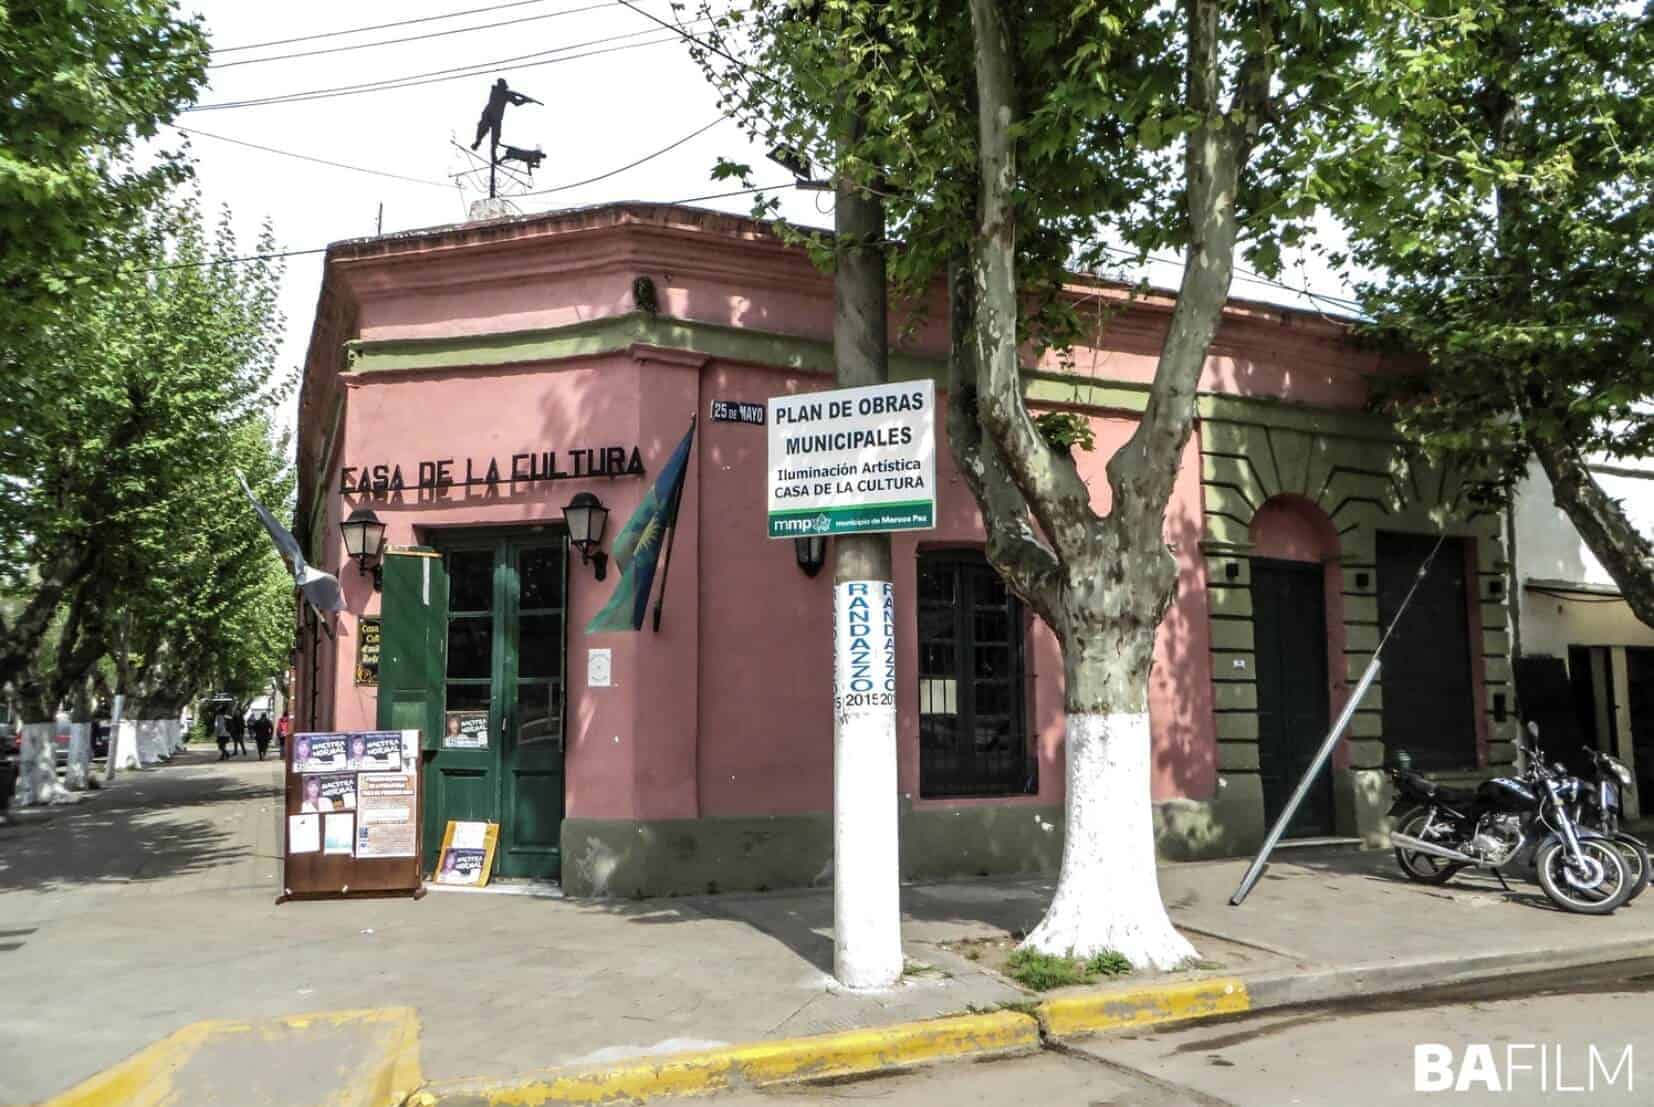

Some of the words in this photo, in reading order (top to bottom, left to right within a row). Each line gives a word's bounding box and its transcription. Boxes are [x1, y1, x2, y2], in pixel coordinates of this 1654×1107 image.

[714, 402, 728, 419] 25
[739, 404, 763, 423] MAYO
[776, 402, 822, 425] PLAN
[829, 400, 853, 419] DE
[858, 392, 924, 416] OBRAS
[785, 426, 912, 455] MUNICIPALES
[340, 464, 405, 493] CASA
[418, 459, 455, 488] DE
[466, 457, 499, 485] LA
[511, 445, 645, 481] CULTURA
[777, 462, 857, 481] Iluminación
[862, 458, 921, 474] Artística
[775, 484, 809, 499] CASA
[814, 481, 831, 496] DE
[836, 480, 853, 494] LA
[857, 476, 924, 492] CULTURA
[774, 518, 812, 532] mmp
[848, 583, 873, 692] RANDAZZO
